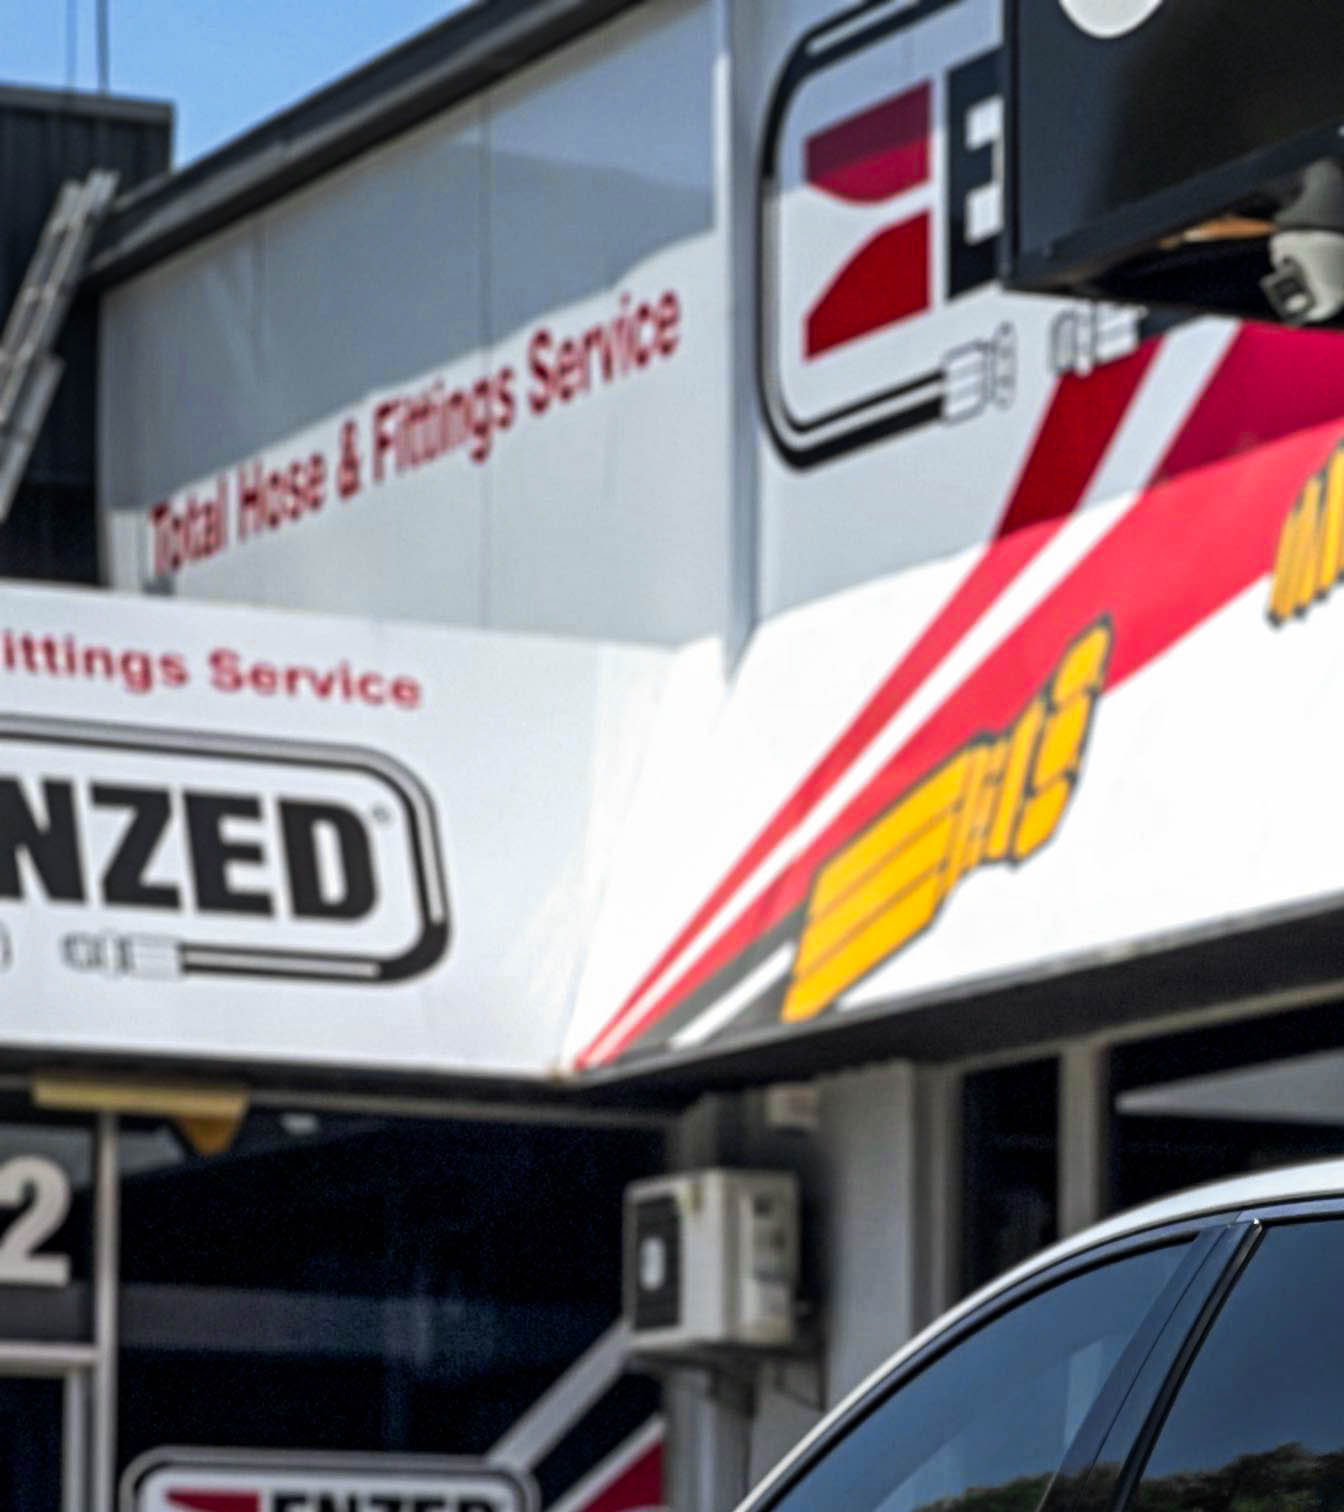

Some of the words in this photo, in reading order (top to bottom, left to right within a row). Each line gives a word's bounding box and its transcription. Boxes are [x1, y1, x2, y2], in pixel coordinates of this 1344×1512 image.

[150, 472, 229, 577] Total
[237, 453, 326, 542] Hose
[336, 419, 361, 500] &
[372, 366, 516, 484] Fittings
[528, 290, 681, 415] Service
[1, 628, 190, 694] ittings
[207, 646, 423, 710] Service
[0, 775, 380, 925] NZED
